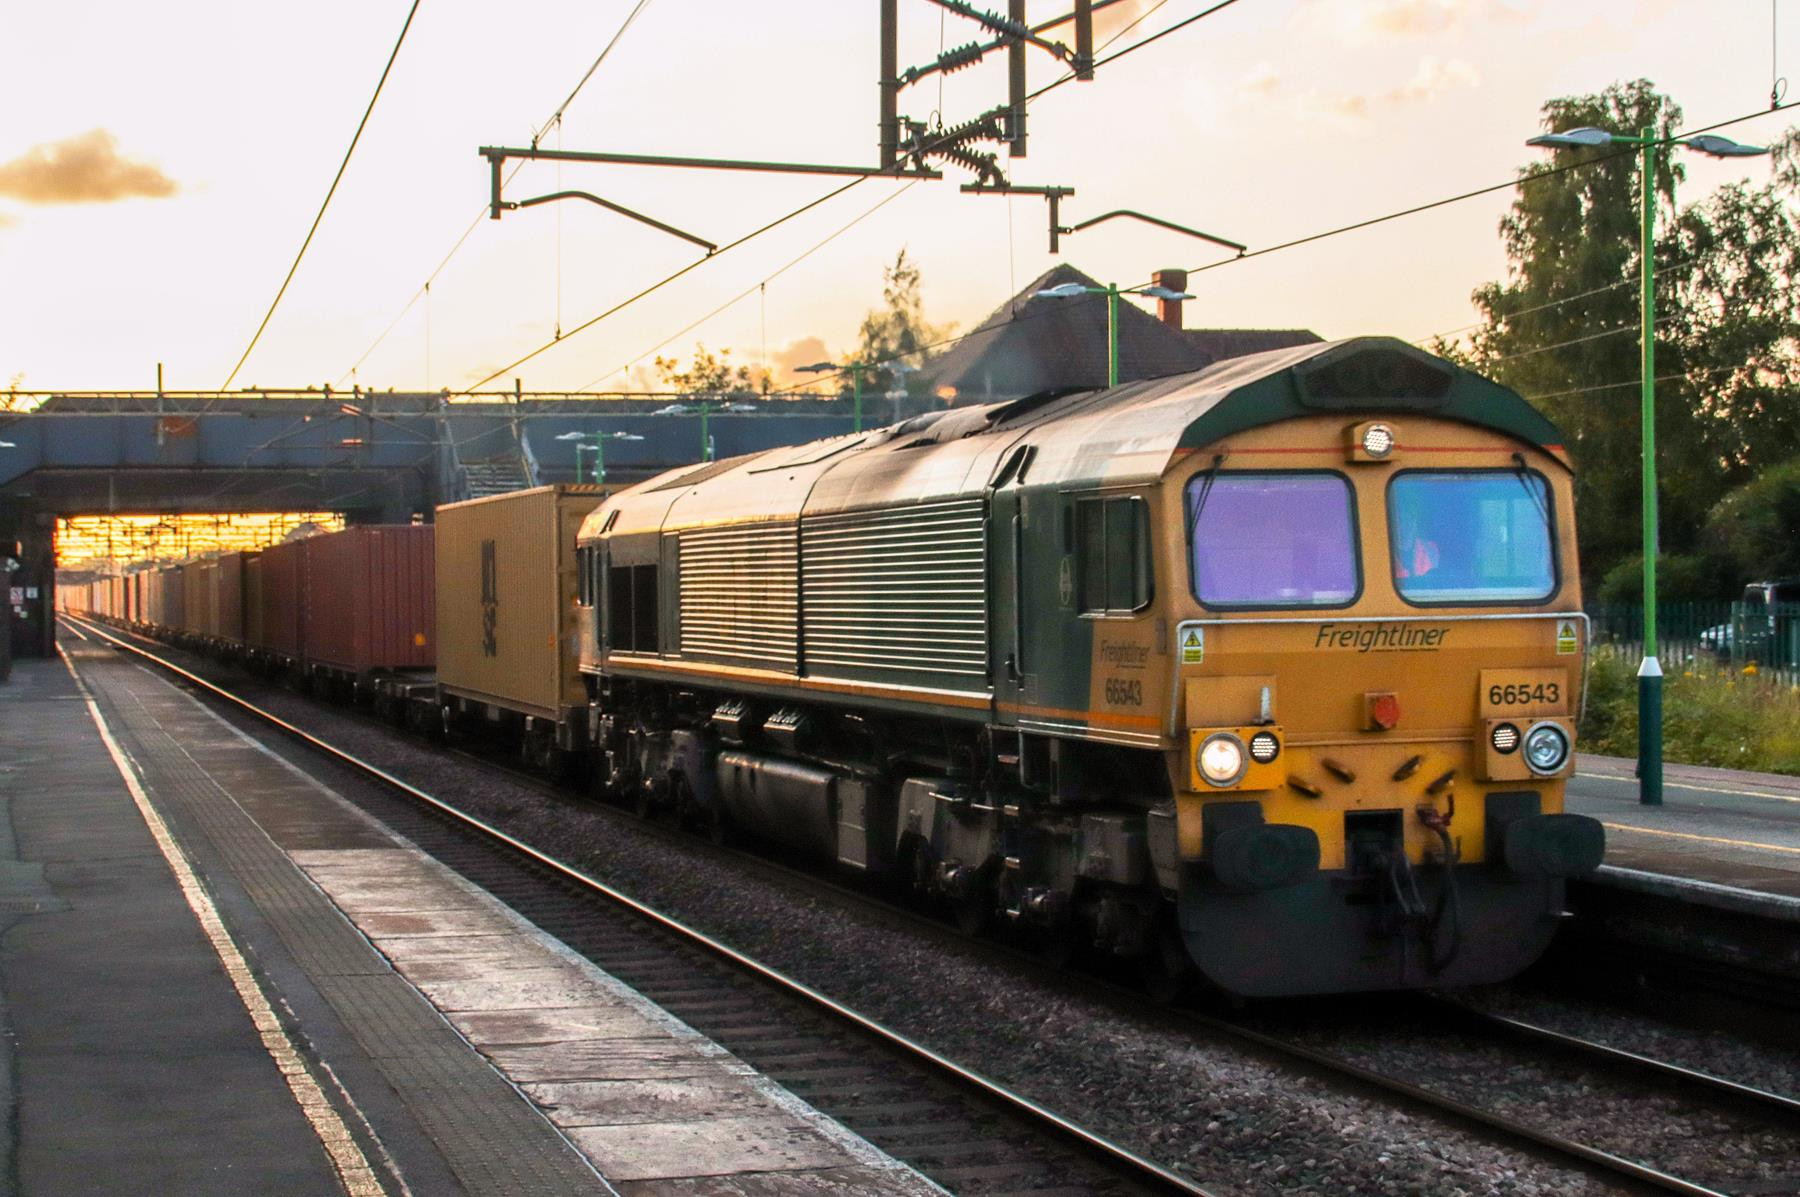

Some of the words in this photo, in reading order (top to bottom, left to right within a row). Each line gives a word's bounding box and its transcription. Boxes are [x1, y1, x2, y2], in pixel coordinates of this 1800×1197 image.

[1315, 622, 1449, 653] Freightliner
[1105, 678, 1141, 705] 66543
[1490, 683, 1559, 705] 66543
